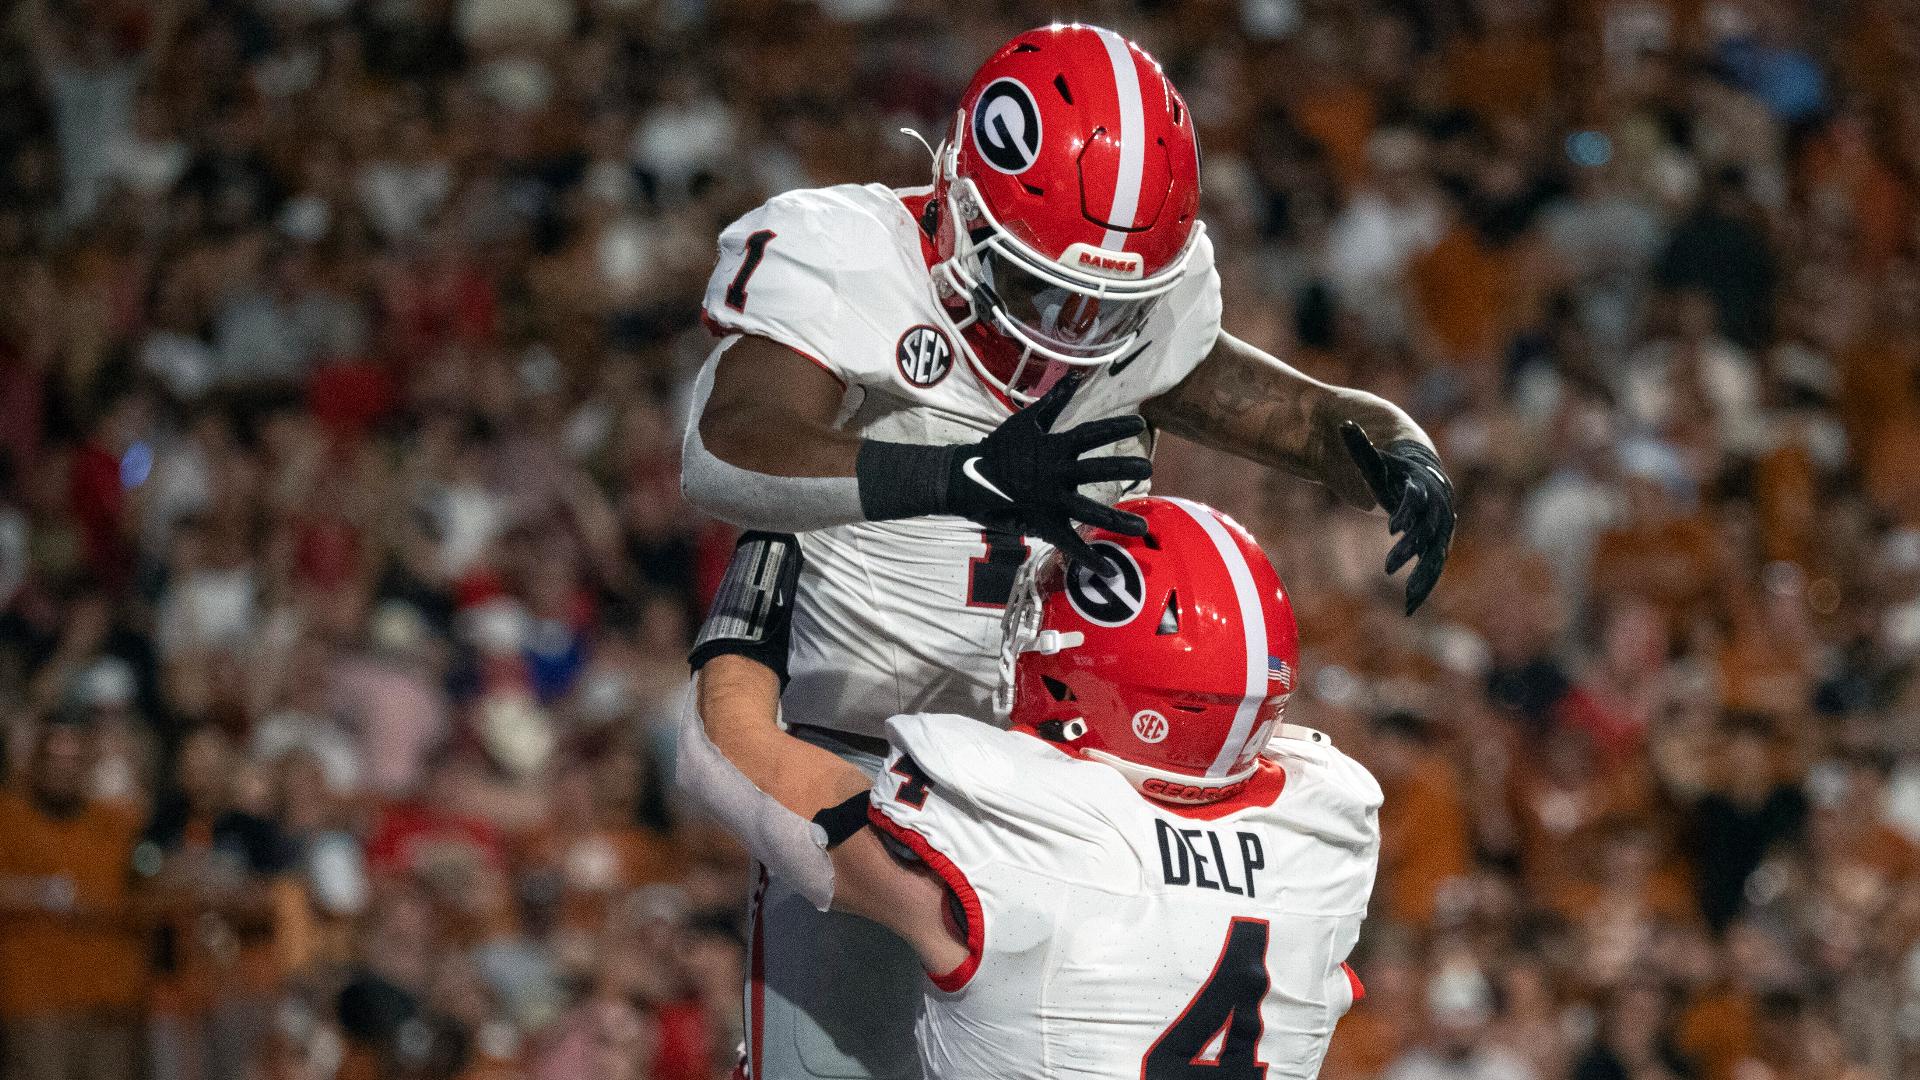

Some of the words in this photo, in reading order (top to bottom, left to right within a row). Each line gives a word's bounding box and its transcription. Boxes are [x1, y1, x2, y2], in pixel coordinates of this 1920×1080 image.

[974, 79, 1040, 172] G
[725, 229, 777, 313] 1
[1079, 252, 1137, 272] DAWGS
[900, 329, 951, 385] SEC
[1066, 542, 1142, 624] G
[1136, 713, 1165, 740] SEC
[1154, 817, 1266, 899] DELP
[1140, 916, 1271, 1080] 4
